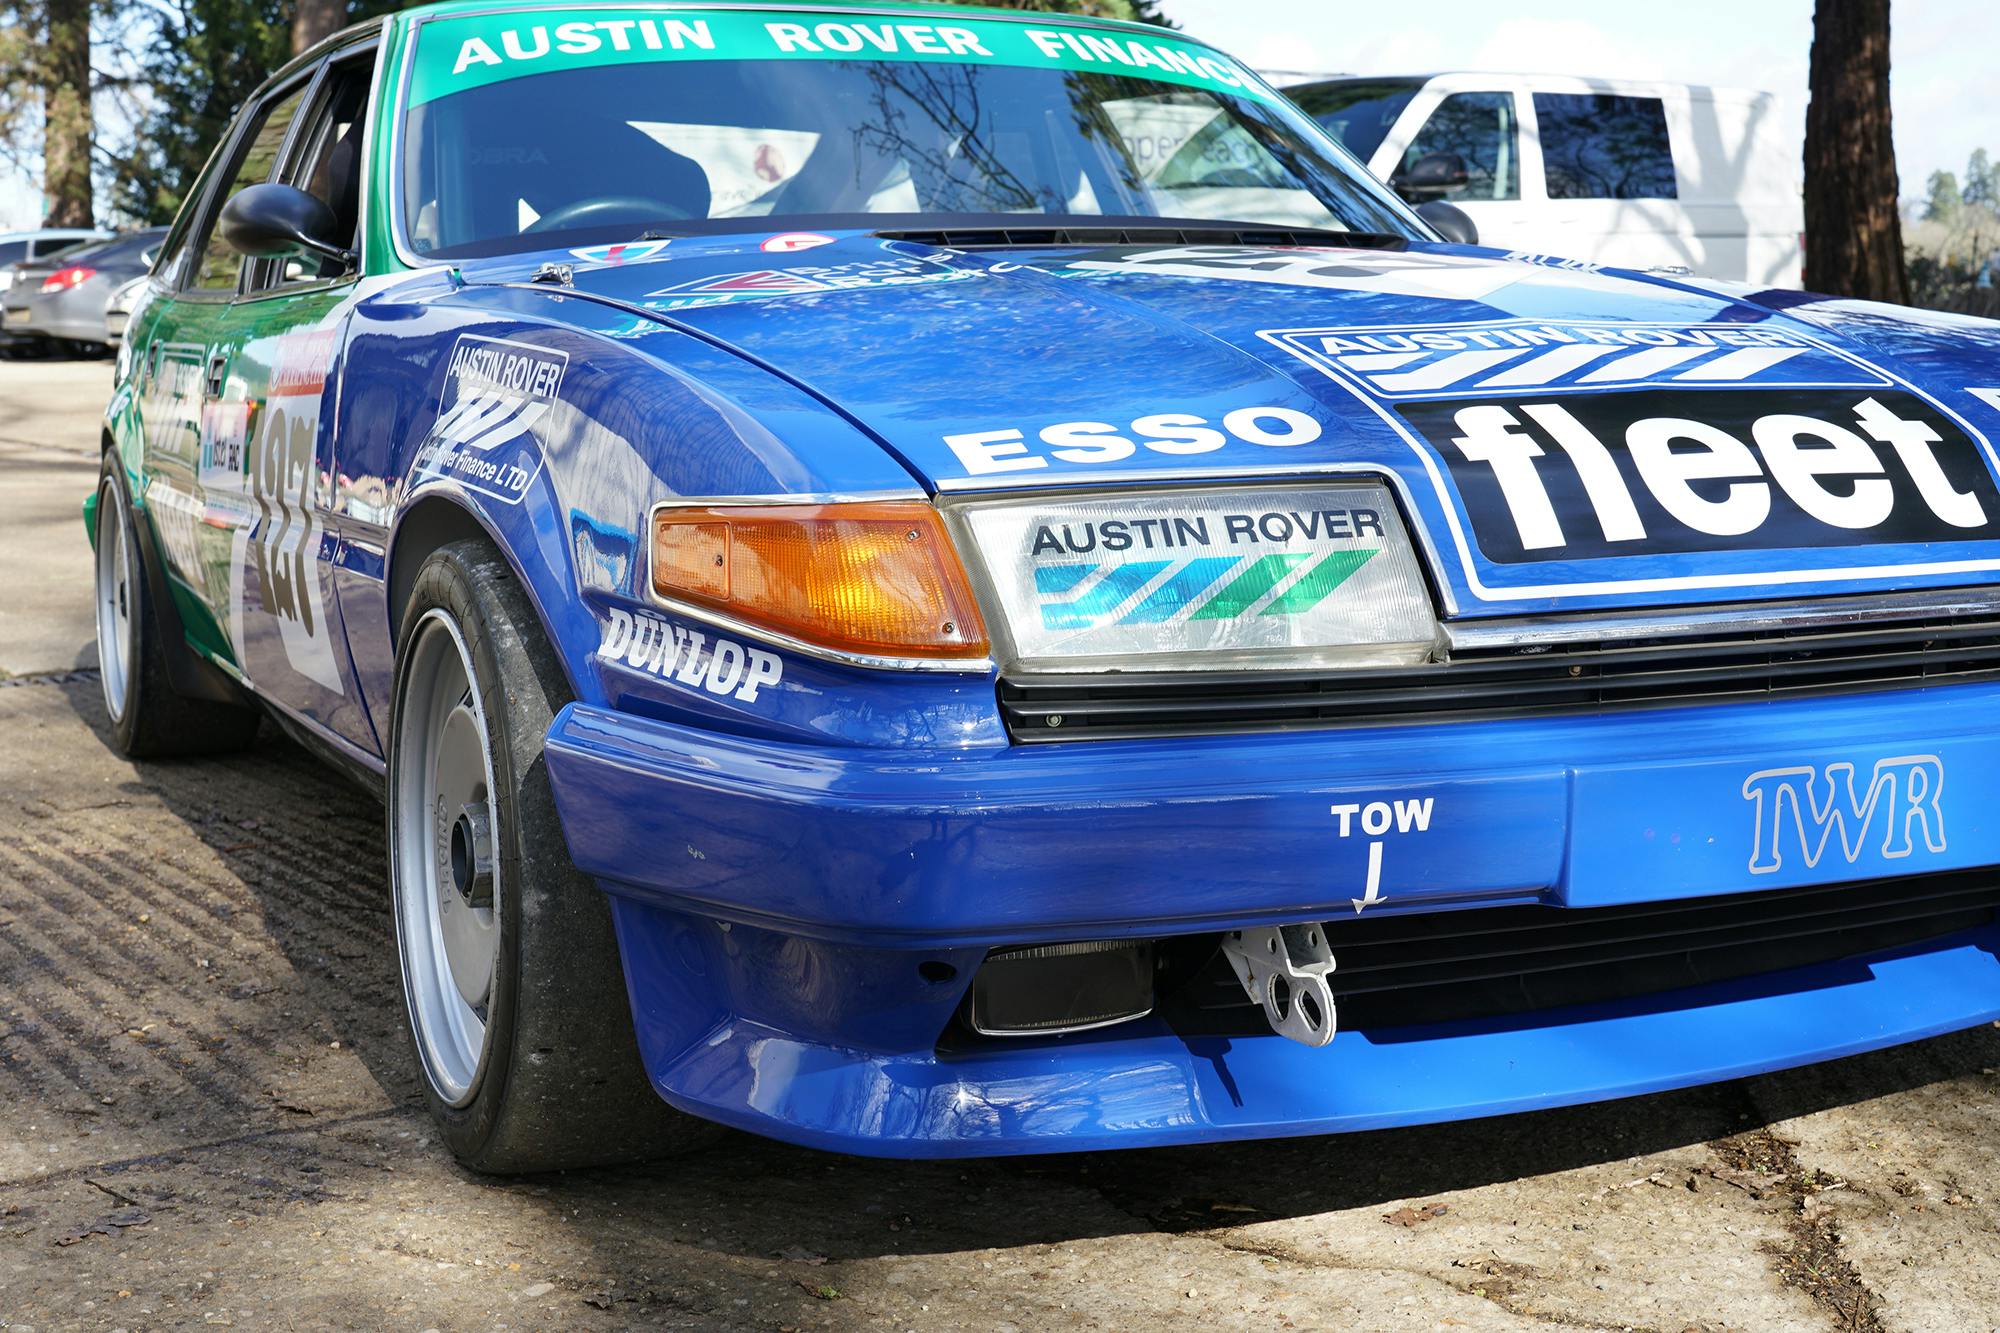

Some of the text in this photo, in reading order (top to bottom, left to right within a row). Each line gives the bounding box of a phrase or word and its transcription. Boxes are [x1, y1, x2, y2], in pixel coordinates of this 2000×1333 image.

[452, 20, 716, 75] AUSTIN
[764, 23, 994, 57] ROVER
[1320, 325, 1807, 355] AUSTIN ROVER
[450, 346, 560, 398] AUSTIN ROVER
[942, 406, 1322, 475] ESSO
[455, 450, 497, 481] Finance
[494, 463, 529, 491] LTD
[1451, 397, 1988, 550] fleet
[1031, 508, 1385, 556] AUSTIN ROVER
[598, 607, 783, 703] DUNLOP
[1331, 798, 1434, 838] TOW
[1742, 755, 1947, 874] TWR
